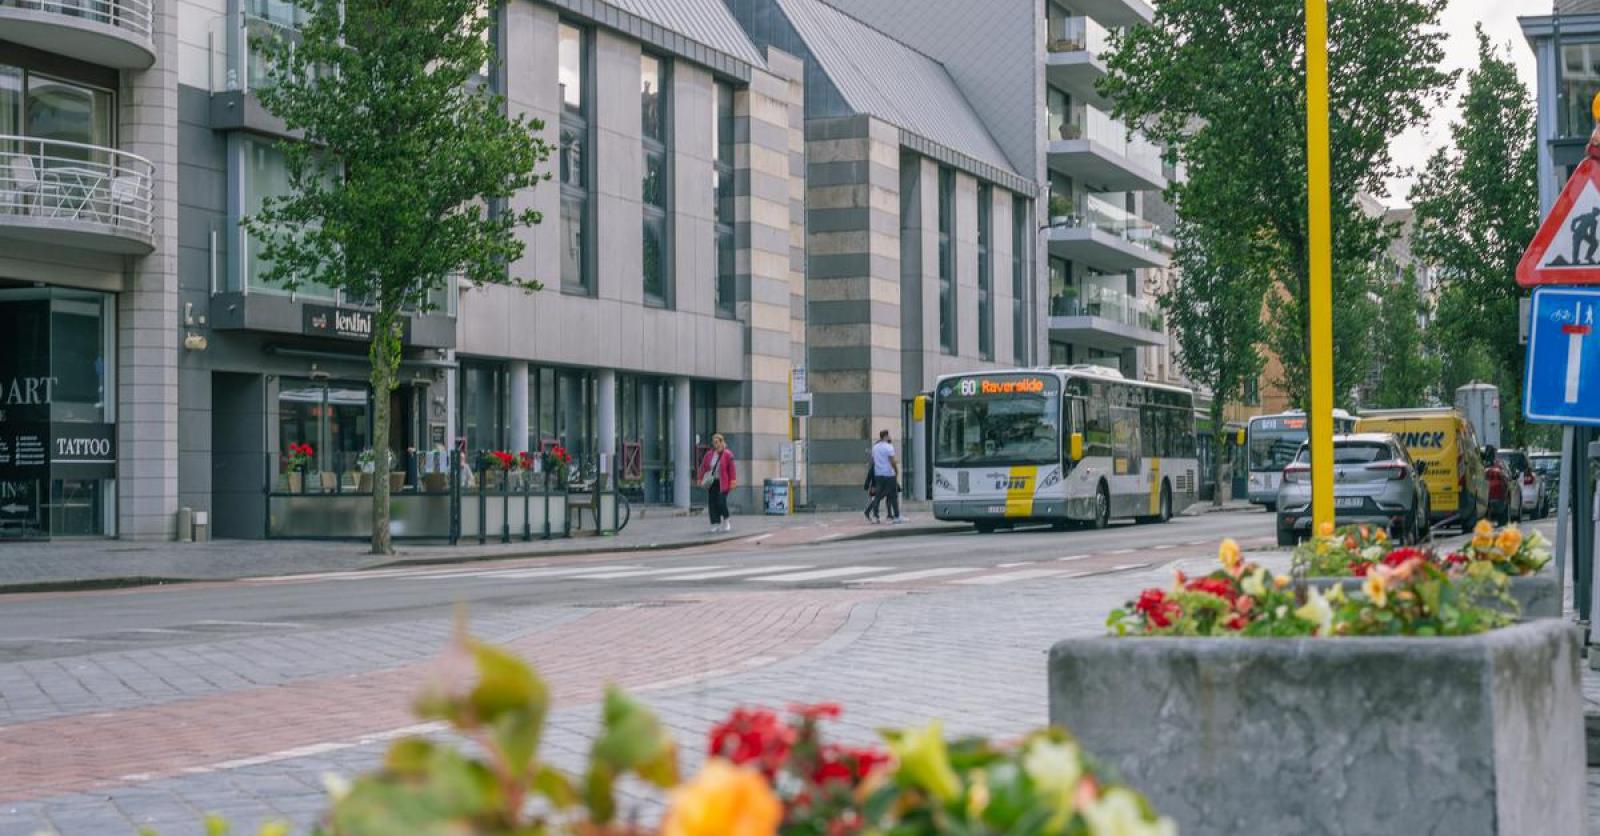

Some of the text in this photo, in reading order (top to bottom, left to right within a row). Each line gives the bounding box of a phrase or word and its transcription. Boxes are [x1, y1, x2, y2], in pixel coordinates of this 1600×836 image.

[7, 376, 58, 405] ART
[961, 380, 976, 396] 60
[56, 438, 110, 456] TATTOO
